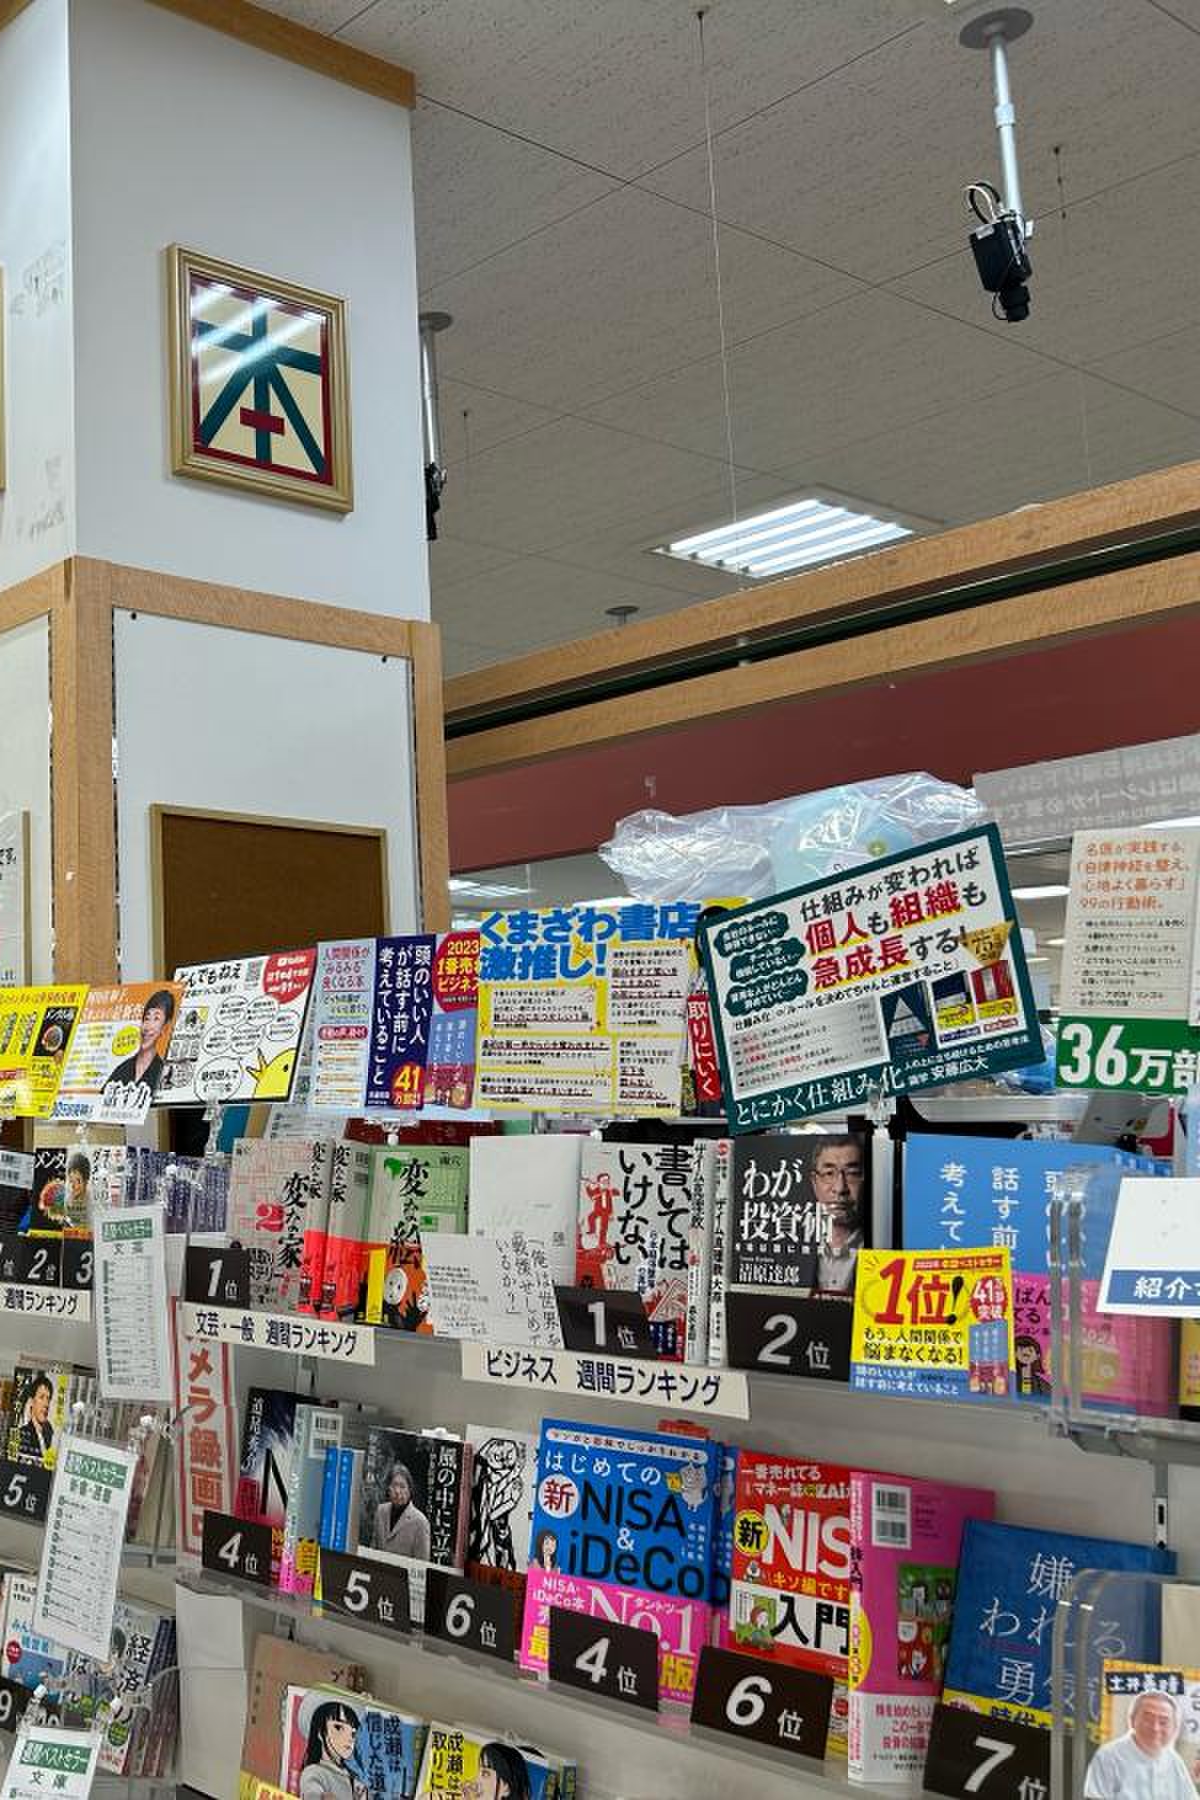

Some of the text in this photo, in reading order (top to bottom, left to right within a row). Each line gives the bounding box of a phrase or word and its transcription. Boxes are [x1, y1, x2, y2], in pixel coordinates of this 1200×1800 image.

[801, 849, 979, 921] 仕組みが変われば
[480, 902, 701, 945] くまざわ書店
[806, 881, 987, 955] 個人も組織も
[447, 940, 480, 956] 2023
[479, 943, 608, 982] 激推し!
[811, 925, 969, 990] 急成長する!
[372, 946, 395, 1086] 考えていること
[391, 944, 412, 1054] が話す前に
[409, 944, 432, 1045] 頭のいい人
[688, 1001, 721, 1096] 取りにいく
[1058, 1021, 1200, 1089] 36万部
[393, 1066, 421, 1091] 41
[736, 1066, 905, 1127] とにかく仕組み化
[613, 1147, 655, 1266] いけない
[742, 1159, 804, 1199] わが
[940, 1162, 967, 1243] 考えて
[656, 1146, 695, 1271] 書いては
[739, 1200, 837, 1244] 投資術
[991, 1167, 1020, 1250] 話す前
[3, 1286, 79, 1315] 週間ランキング
[207, 1258, 239, 1301] 1位
[873, 1257, 965, 1326] 1位!
[196, 1311, 358, 1355] 文芸・一般 週間ランキング
[586, 1301, 640, 1350] 1位
[756, 1313, 831, 1371] 2位
[863, 1344, 964, 1365] 悩まなくなる!
[864, 1327, 964, 1345] もう、人間関係で
[486, 1349, 722, 1406] ビジネス 週間ランキング
[187, 1342, 224, 1536] メラ録画
[546, 1447, 661, 1486] はじめての
[741, 1463, 822, 1482] 一番売れてる
[542, 1479, 687, 1538] 新 NISA
[738, 1515, 763, 1551] 新
[217, 1530, 259, 1575] 4位
[568, 1530, 706, 1600] iDeCo
[616, 1527, 634, 1551] &
[343, 1569, 395, 1622] 5位
[1025, 1552, 1076, 1601] 嫌
[446, 1593, 498, 1649] 6位
[769, 1593, 850, 1657] 入門
[574, 1636, 638, 1695] 4位
[725, 1674, 804, 1741] 6位
[962, 1735, 1048, 1800] 7位
